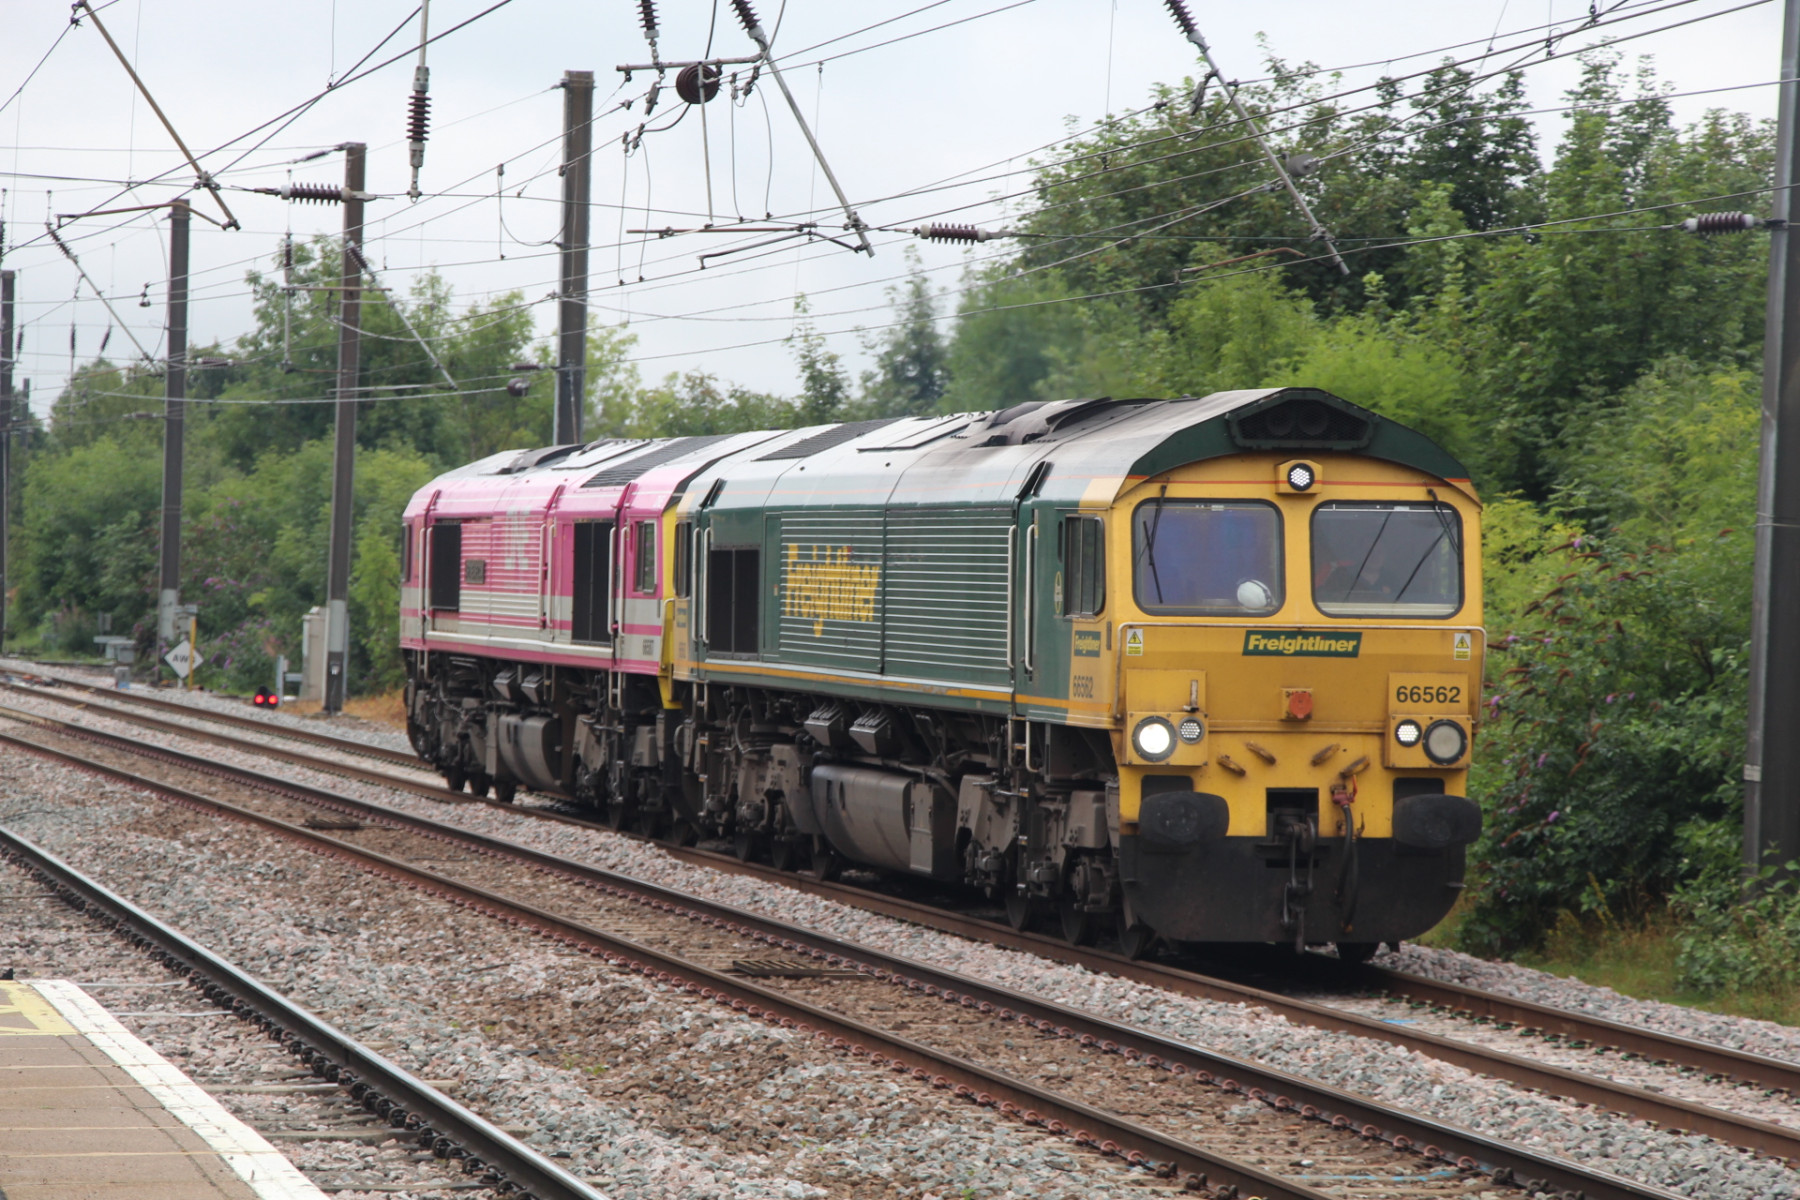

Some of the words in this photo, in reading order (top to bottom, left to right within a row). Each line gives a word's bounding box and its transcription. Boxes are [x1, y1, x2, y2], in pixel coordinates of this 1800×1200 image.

[1248, 634, 1358, 655] Freightliner
[1073, 675, 1094, 698] 66562
[1396, 685, 1461, 704] 66562
